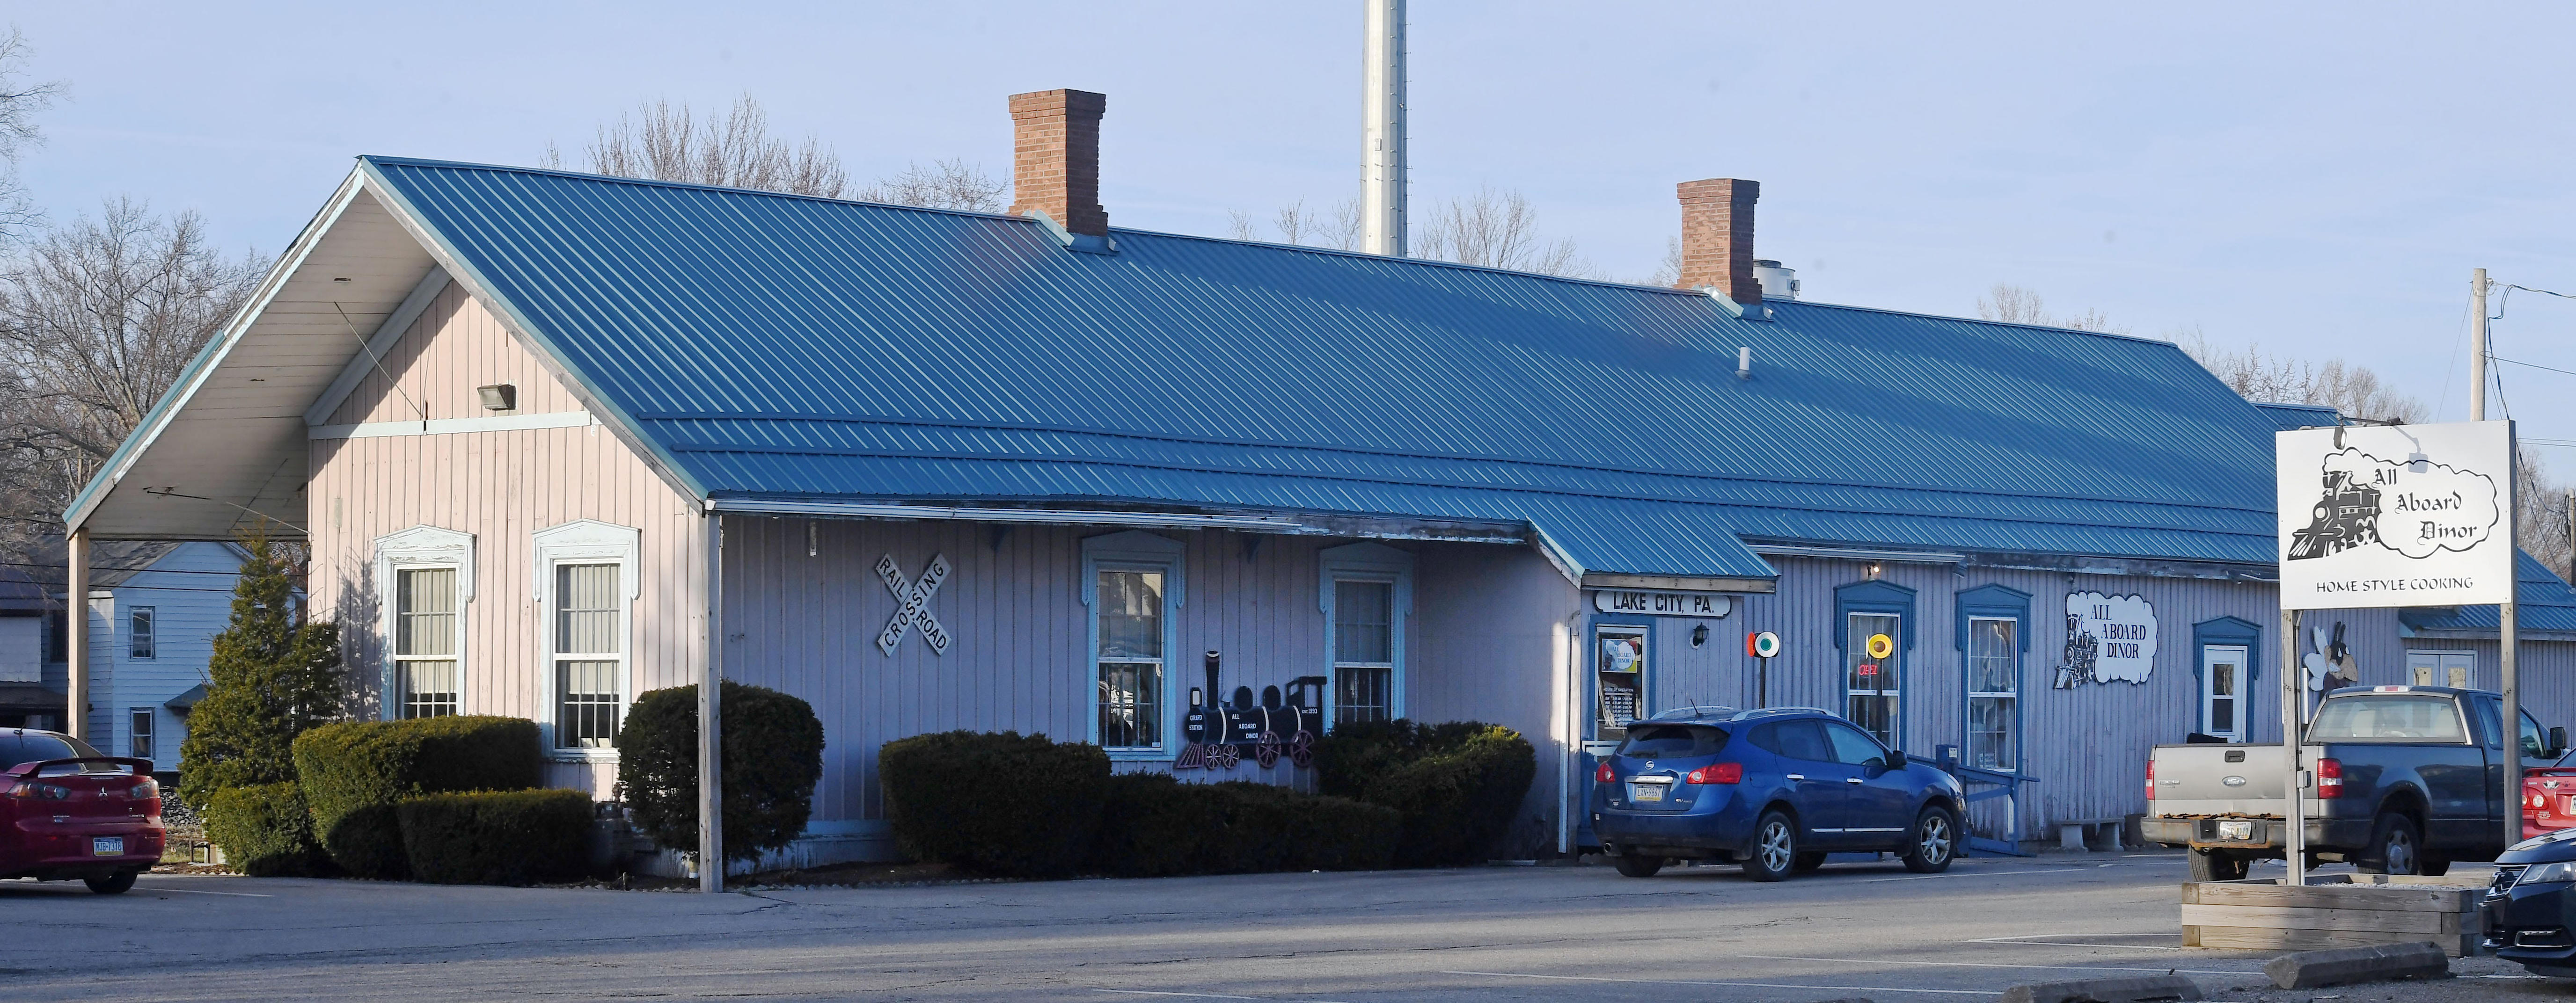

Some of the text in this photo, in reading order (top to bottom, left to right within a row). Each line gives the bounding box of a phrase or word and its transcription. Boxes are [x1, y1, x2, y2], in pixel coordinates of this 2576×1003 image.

[2371, 468, 2397, 488] All
[2394, 489, 2462, 514] Aboard
[2417, 521, 2477, 545] Dinor
[2317, 577, 2473, 592] HOME STYLE COOKING
[880, 558, 946, 649] RAIL ROAD
[885, 563, 944, 647] CROSSING
[1614, 592, 1714, 614] LAKE CITY, PA.
[2091, 604, 2112, 620] ALL
[2101, 624, 2146, 640] ABOARD
[2107, 642, 2139, 659] DINOR
[1859, 664, 1878, 675] OPEN
